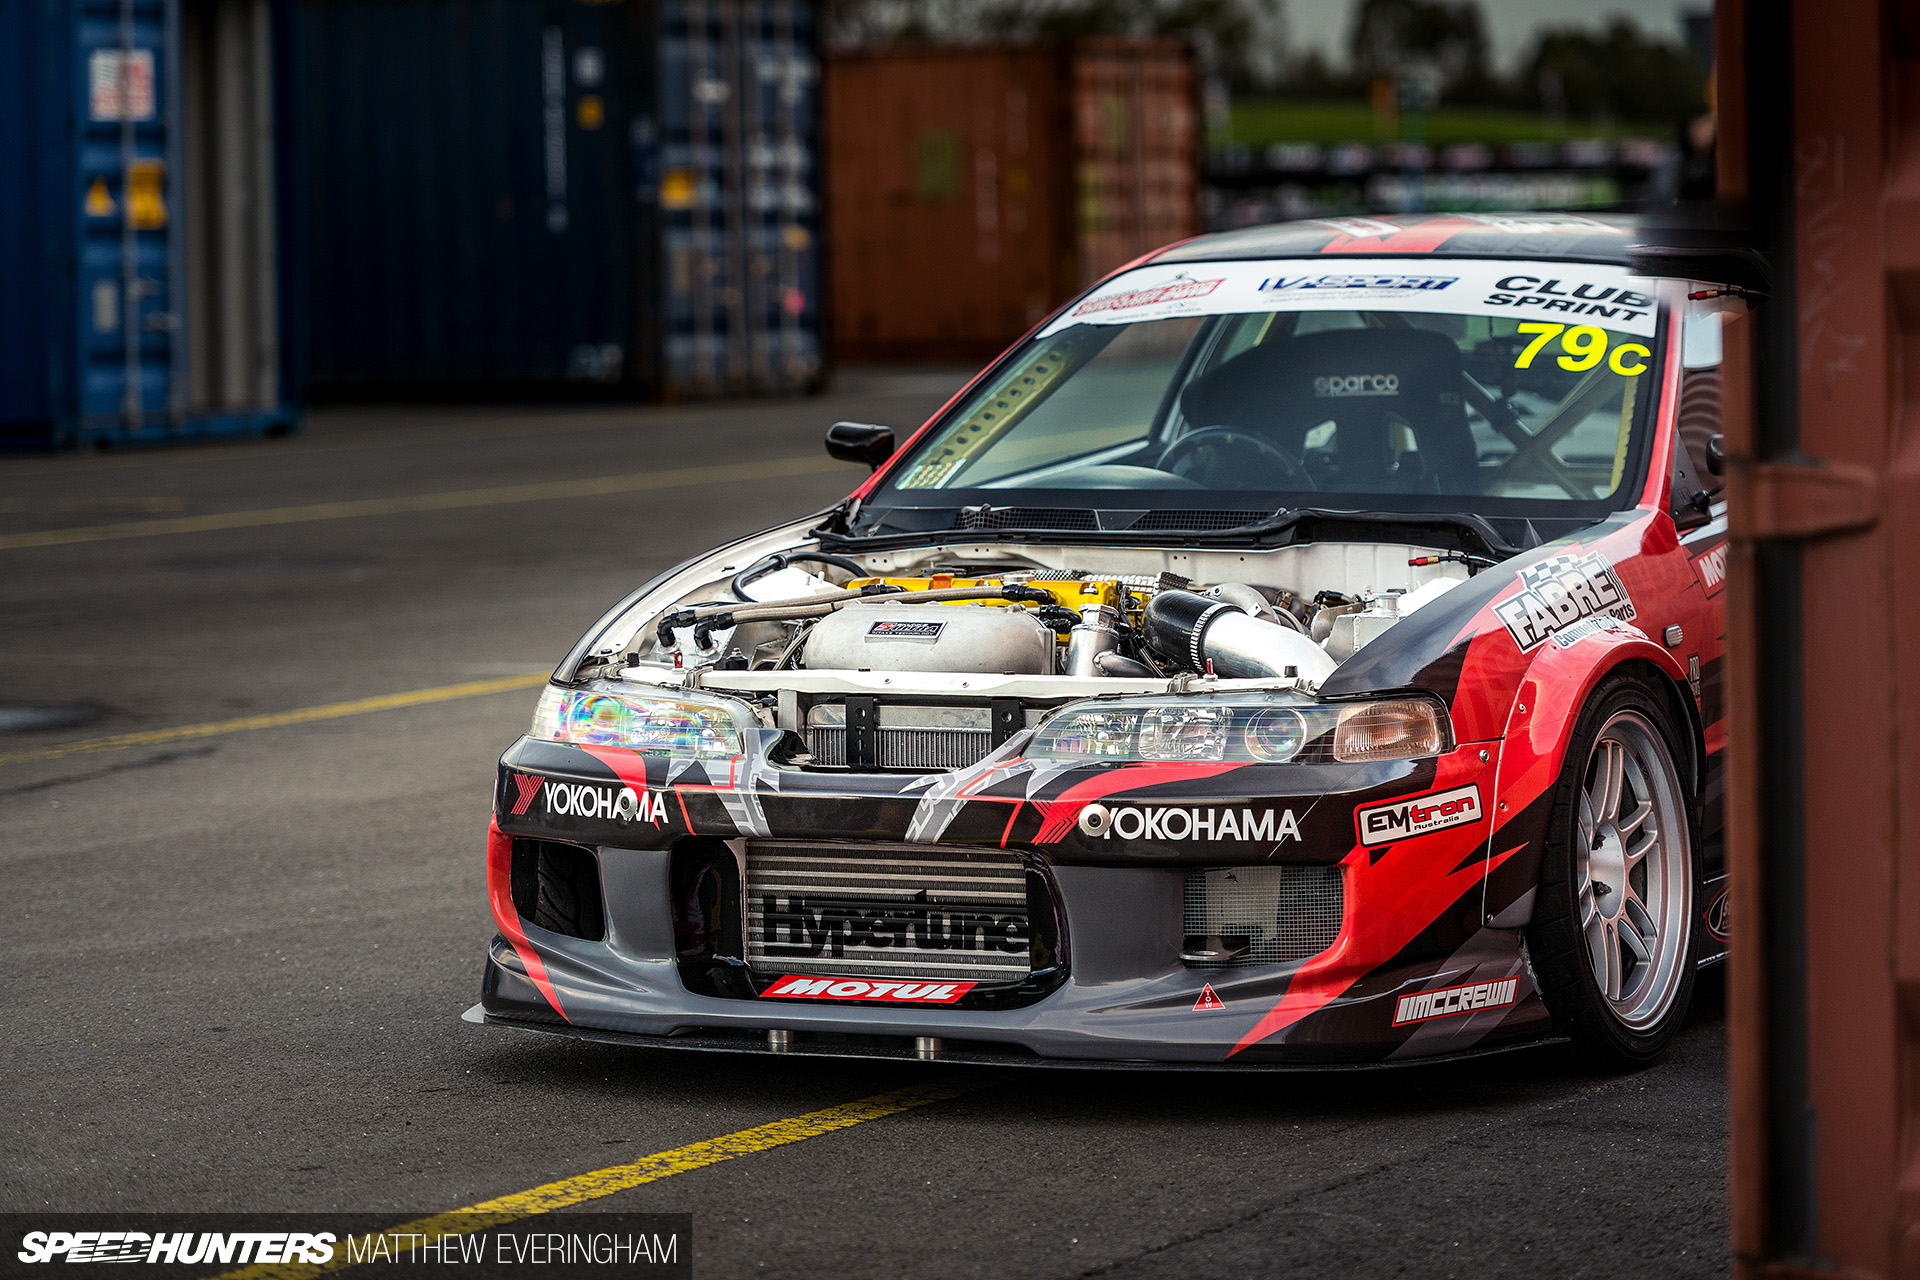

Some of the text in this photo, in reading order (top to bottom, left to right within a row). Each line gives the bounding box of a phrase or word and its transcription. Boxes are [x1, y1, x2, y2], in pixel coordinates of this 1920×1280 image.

[1495, 276, 1653, 307] CLUB
[1483, 293, 1649, 321] SPRINT
[1413, 815, 1459, 831] Australia
[763, 889, 1029, 958] Hypertune
[772, 979, 959, 1000] MOTUL
